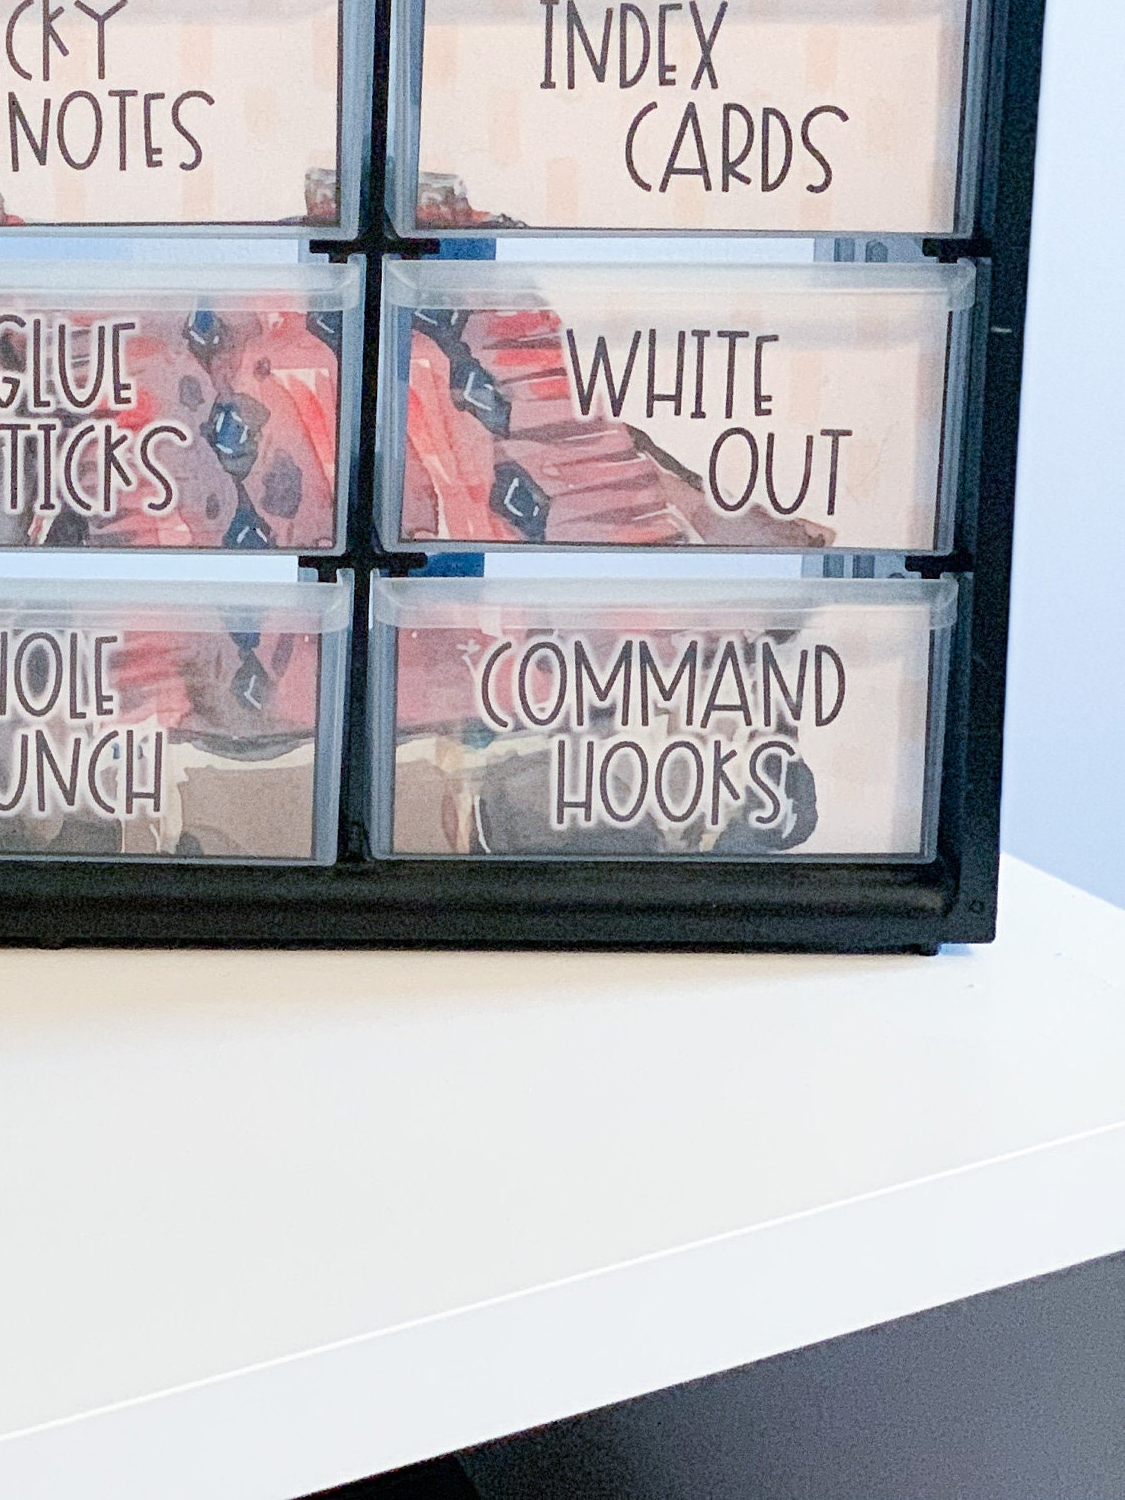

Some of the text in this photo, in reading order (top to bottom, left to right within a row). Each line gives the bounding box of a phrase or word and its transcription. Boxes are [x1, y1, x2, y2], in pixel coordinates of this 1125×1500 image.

[7, 90, 216, 172] NOTES
[625, 101, 850, 194] CARDS
[566, 328, 780, 419] WHITE
[709, 427, 853, 516] OUT
[481, 640, 846, 729] COMMAND
[556, 738, 796, 826] HOOKS
